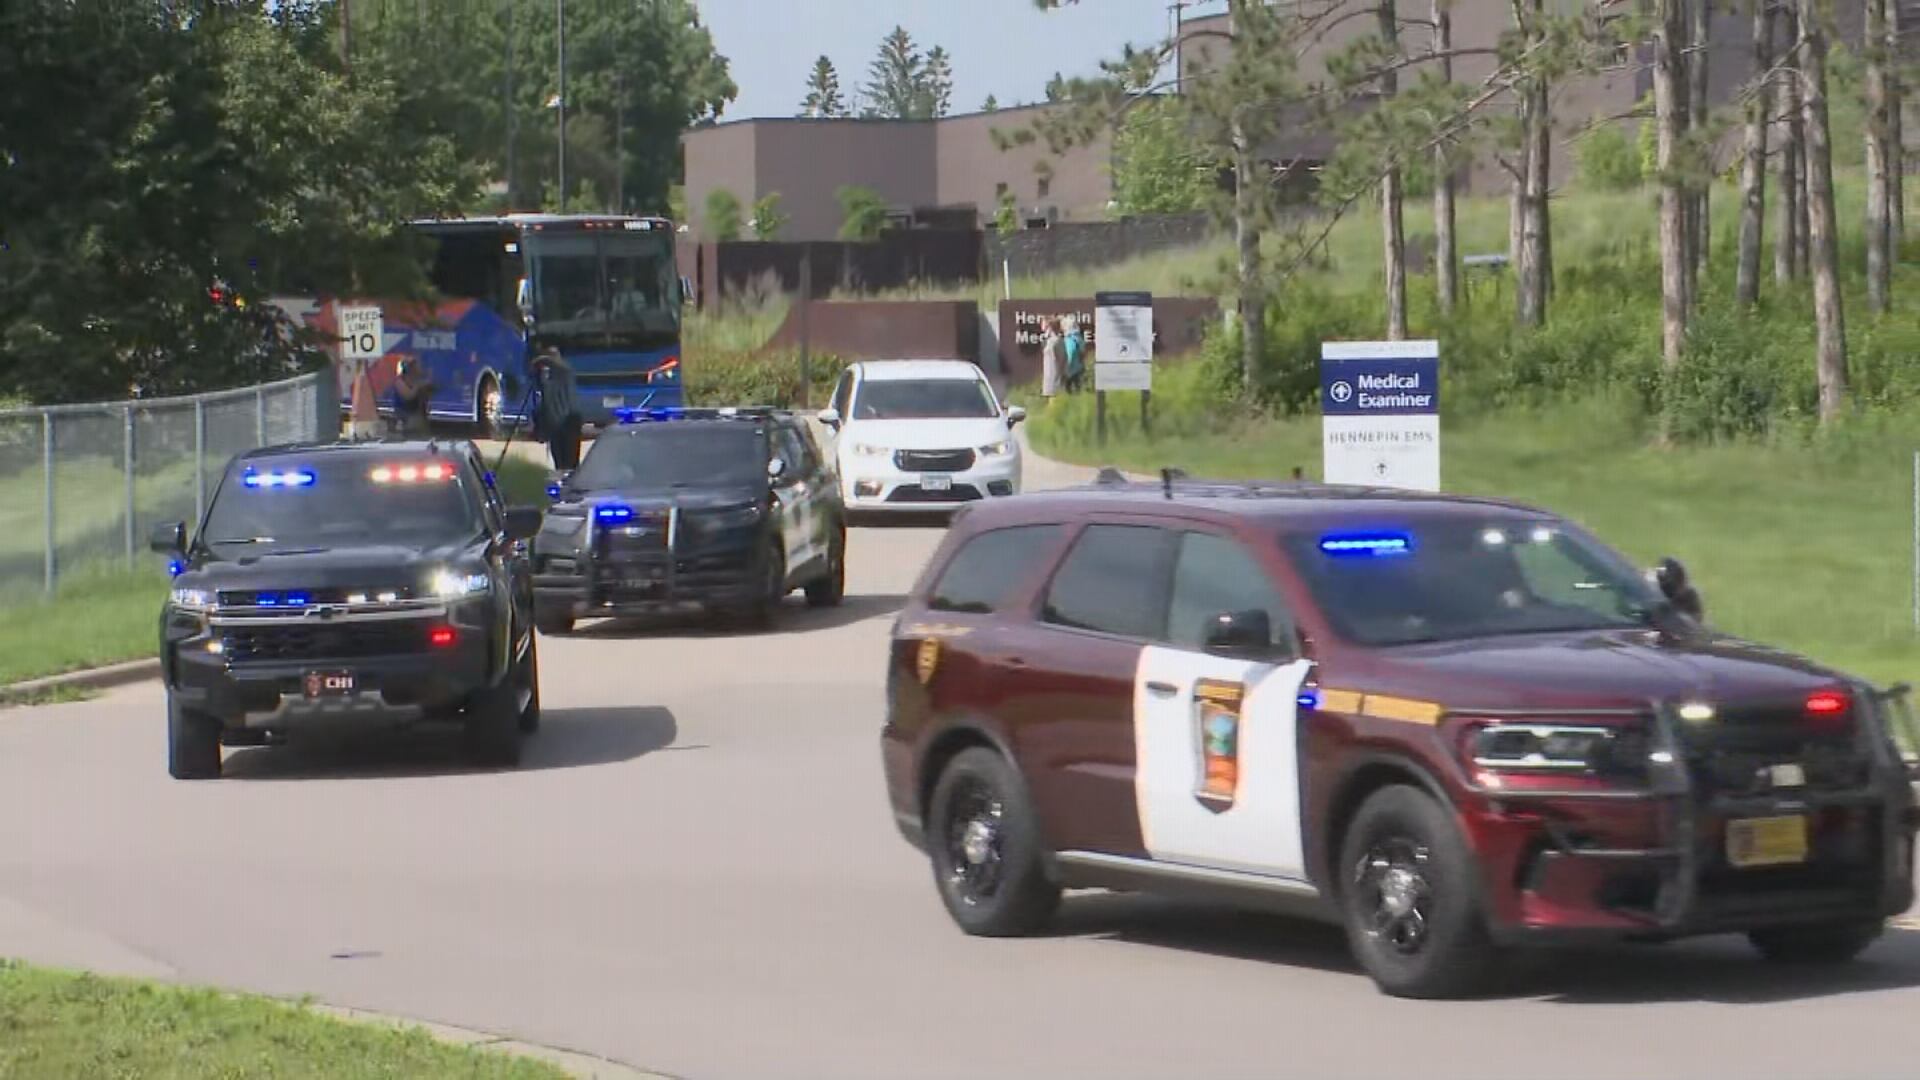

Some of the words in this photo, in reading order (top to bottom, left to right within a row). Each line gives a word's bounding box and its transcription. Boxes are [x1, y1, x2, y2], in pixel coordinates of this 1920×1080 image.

[345, 311, 378, 321] SPEED
[1015, 310, 1092, 326] Henpin
[349, 322, 374, 332] LIMIT
[351, 333, 375, 353] 10
[1358, 373, 1419, 389] Medical
[1358, 392, 1432, 408] Examiner
[1328, 431, 1399, 443] HENNEPIN
[1404, 431, 1433, 442] EMS
